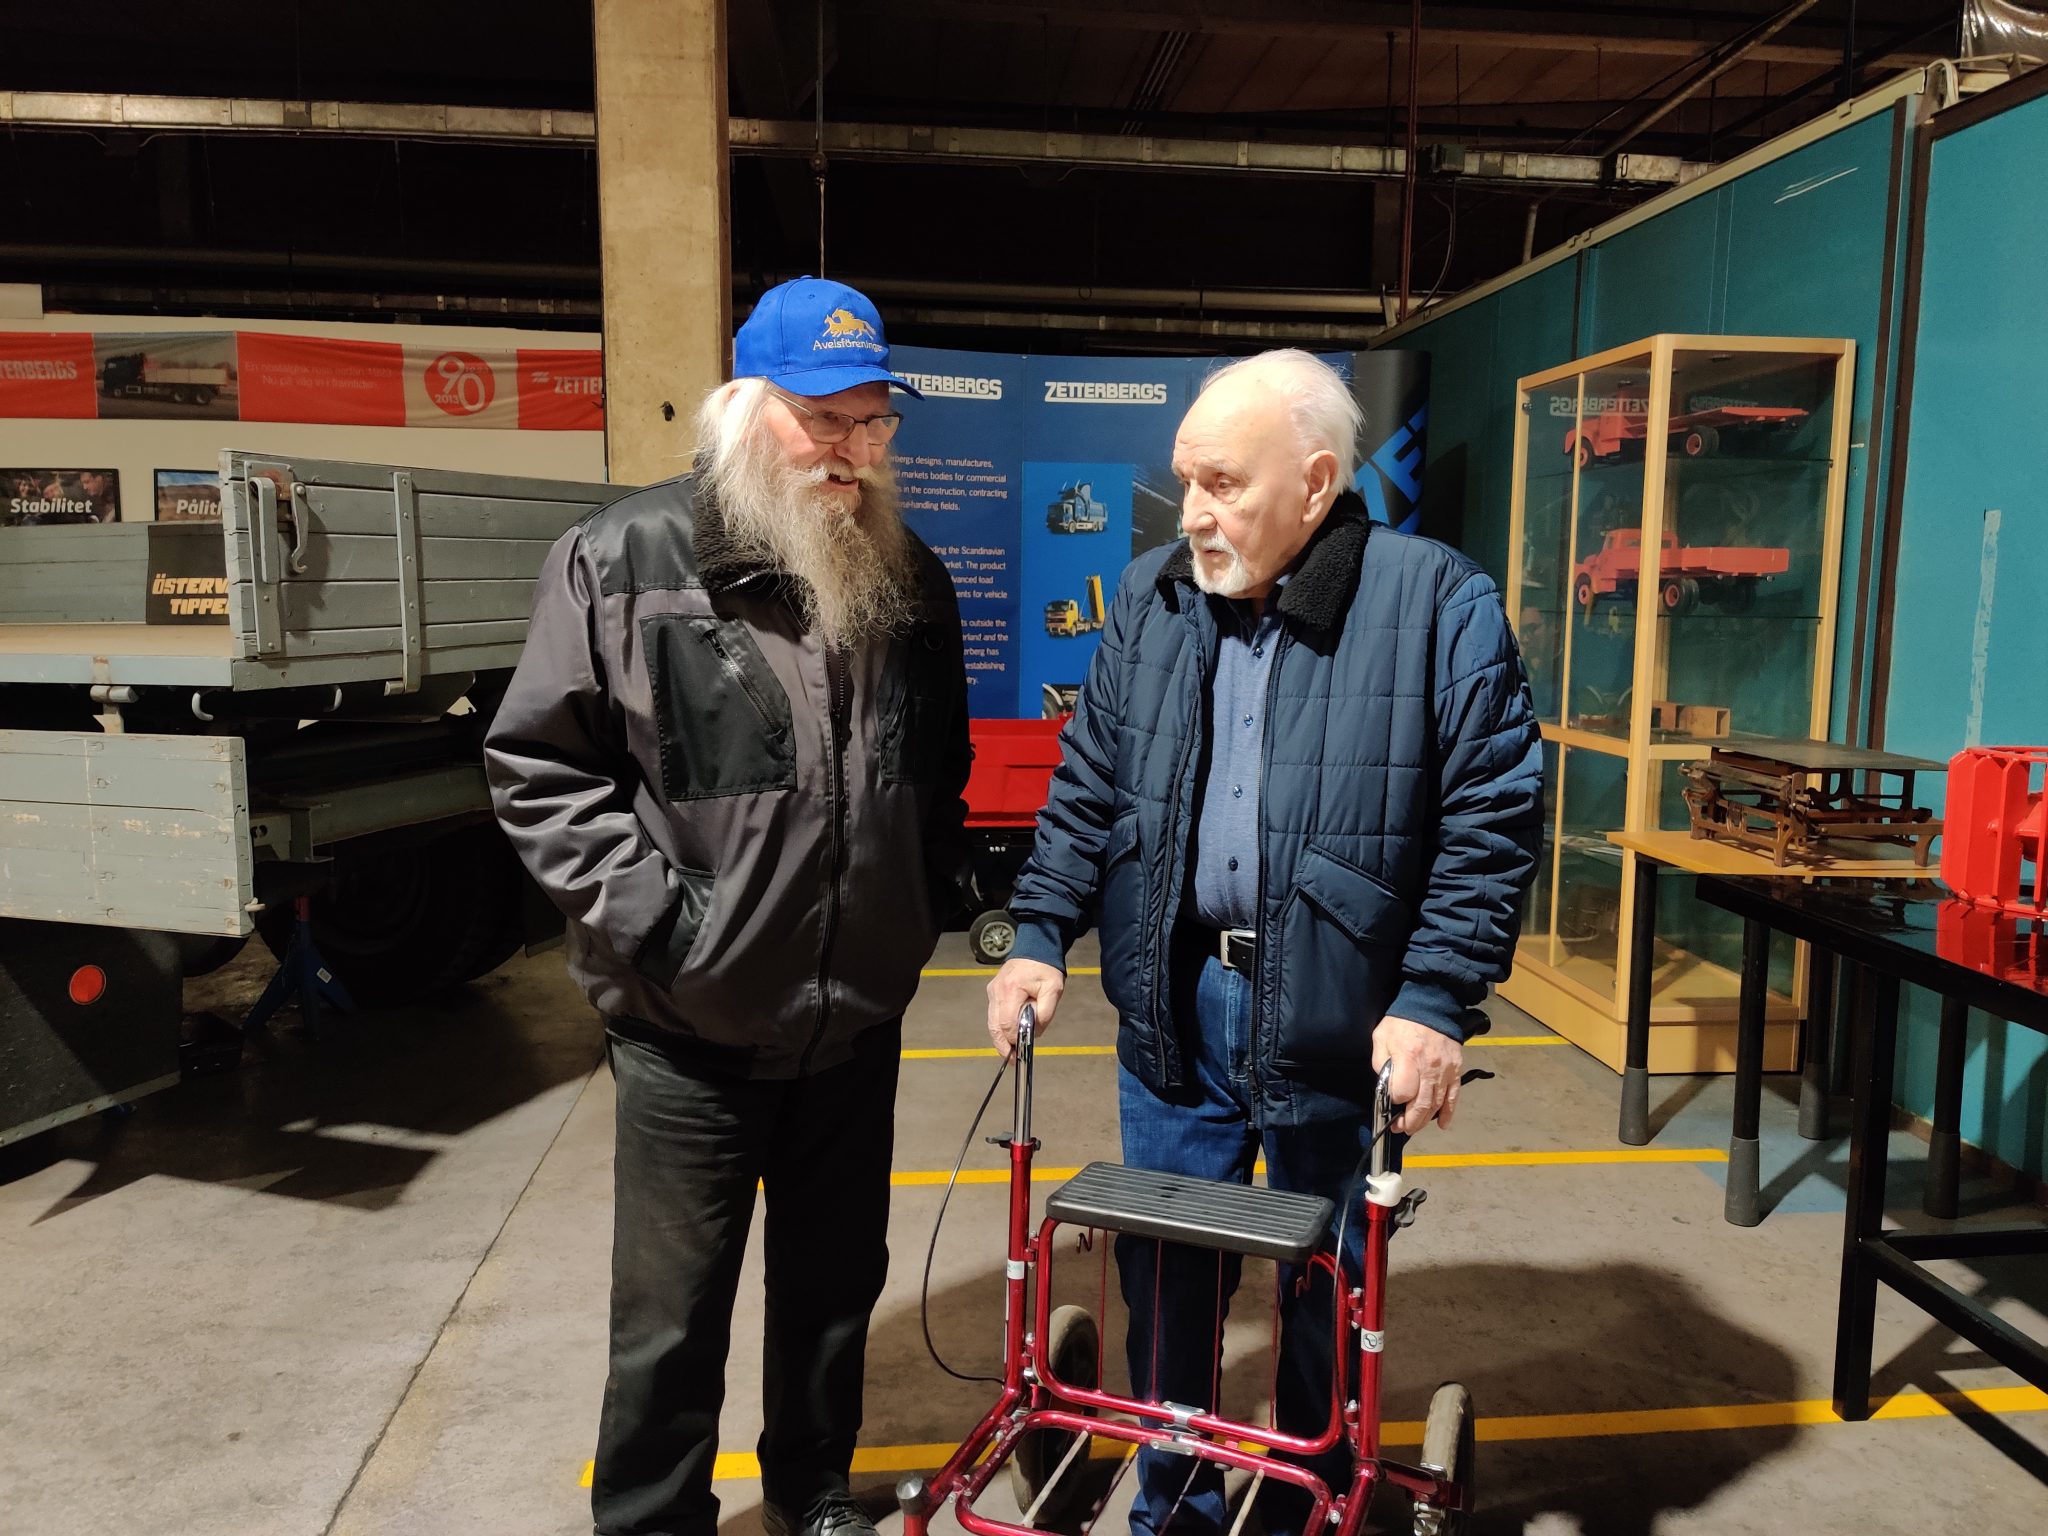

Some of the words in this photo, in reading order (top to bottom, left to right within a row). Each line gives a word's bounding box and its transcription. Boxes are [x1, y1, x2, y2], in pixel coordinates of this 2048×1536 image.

[888, 371, 1002, 400] TTERBERGS
[1044, 381, 1167, 404] ZETTERBERGS
[435, 393, 461, 405] 2013
[915, 456, 944, 467] designs,
[945, 458, 994, 468] manufactures,
[901, 470, 929, 480] markets
[930, 472, 953, 481] bodies
[954, 472, 965, 481] for
[966, 474, 1007, 483] commercial
[910, 486, 922, 494] the
[923, 486, 968, 497] construction,
[969, 488, 1008, 499] contracting
[10, 497, 93, 514] Stabilitet
[940, 501, 961, 511] fields.
[948, 546, 960, 555] the
[961, 546, 1006, 556] Scandinavian
[965, 561, 979, 570] The
[979, 562, 1007, 571] product
[152, 572, 230, 595] ÖSTERV
[978, 576, 994, 584] load
[972, 590, 983, 598] for
[984, 591, 1008, 599] vehicle
[169, 598, 230, 615] TIPPE
[968, 619, 994, 627] outside
[994, 619, 1007, 628] the
[997, 633, 1009, 641] the
[964, 662, 1006, 672] establishing
